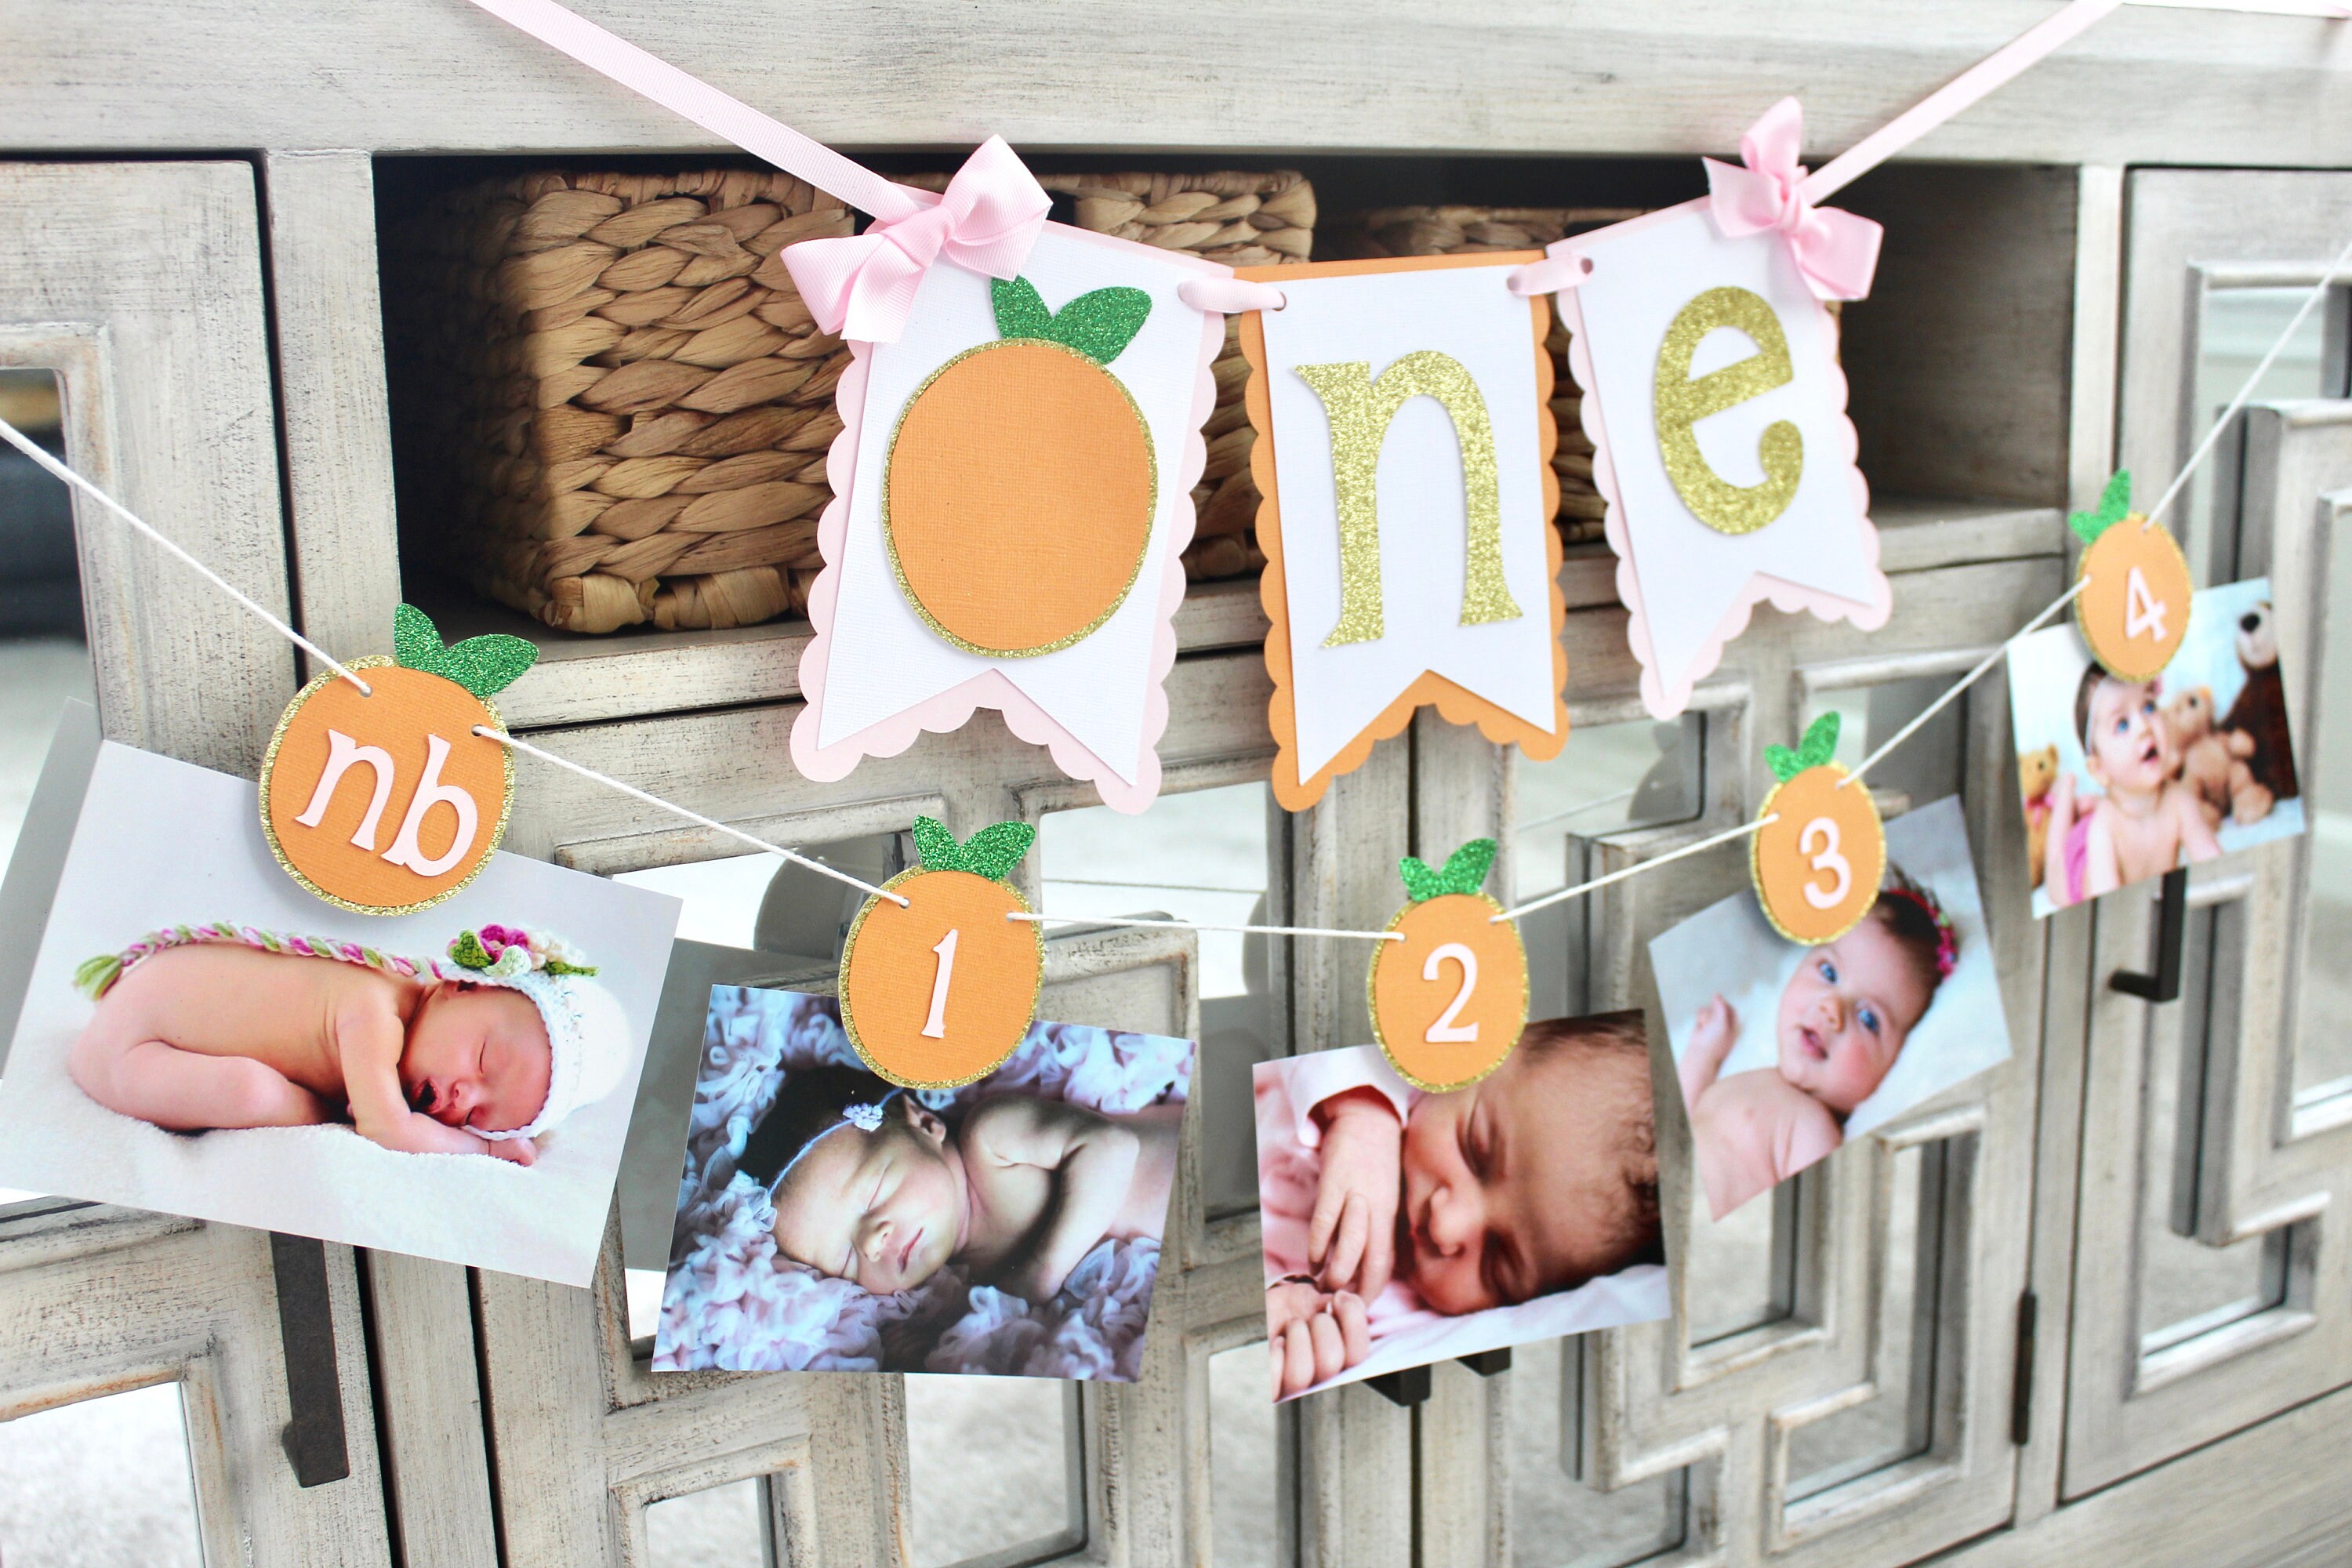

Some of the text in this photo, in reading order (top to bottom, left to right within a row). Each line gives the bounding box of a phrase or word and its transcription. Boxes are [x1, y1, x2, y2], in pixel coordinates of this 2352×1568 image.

[2124, 565, 2169, 643] 4
[295, 728, 479, 877] nb
[1798, 816, 1852, 909] 3
[920, 928, 959, 1040] 1
[1422, 942, 1479, 1044] 2
